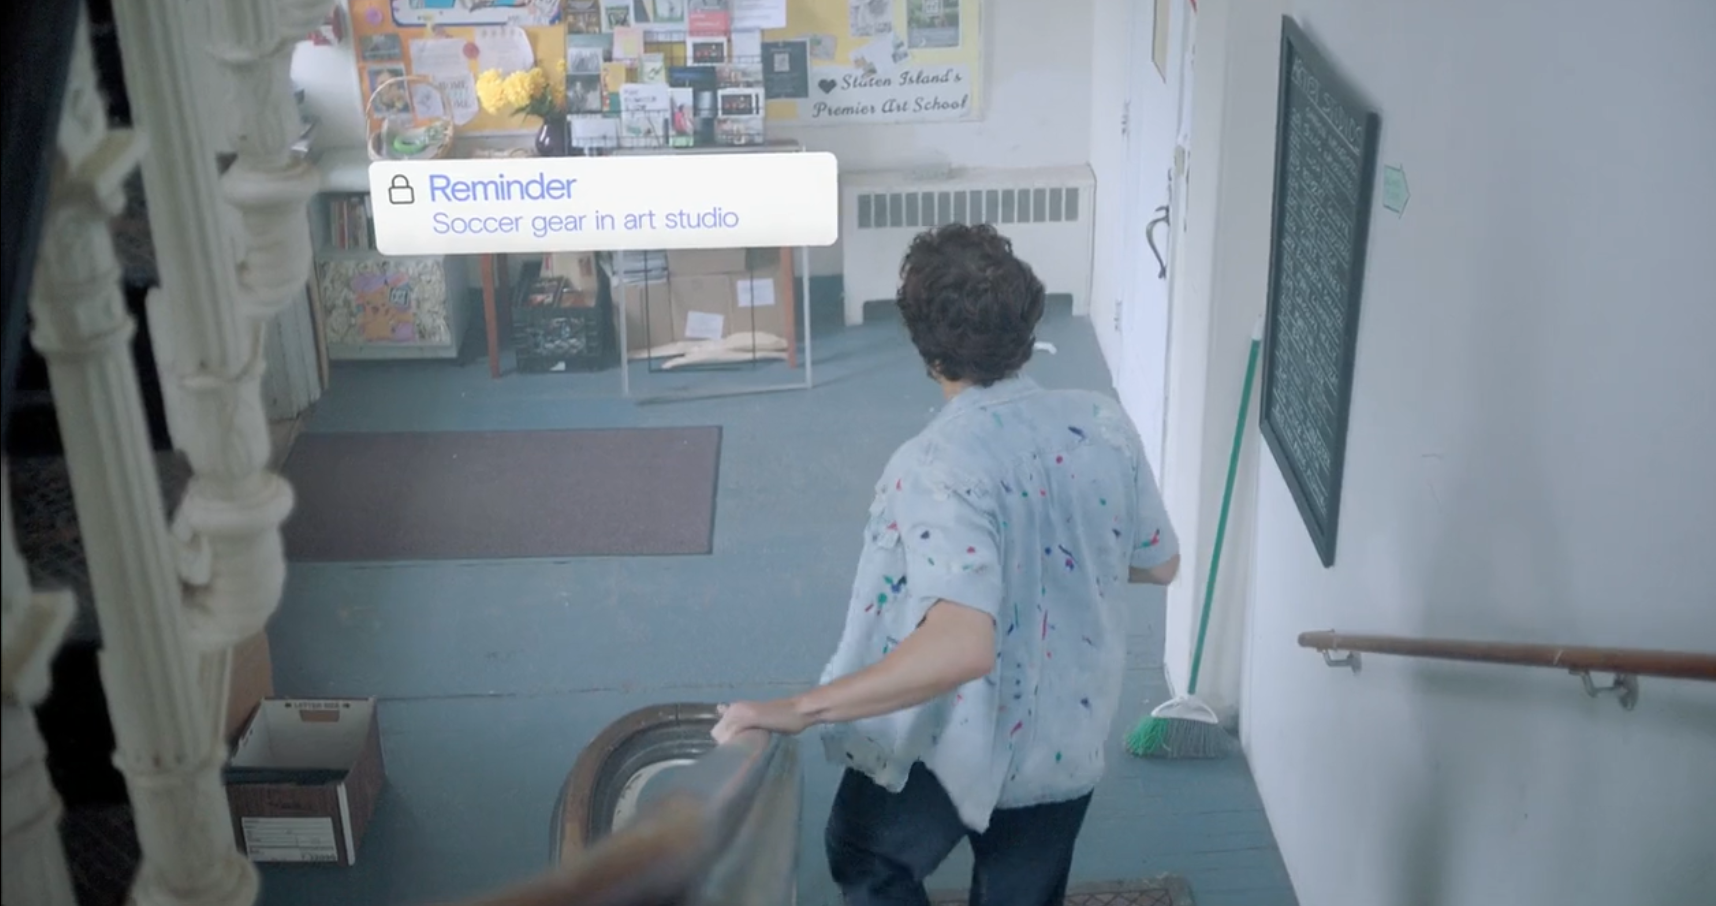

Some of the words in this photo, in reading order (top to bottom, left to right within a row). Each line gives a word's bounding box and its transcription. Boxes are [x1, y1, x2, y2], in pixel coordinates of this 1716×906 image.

[840, 73, 892, 91] Staten
[899, 69, 963, 87] Island's
[811, 101, 876, 119] Premier
[881, 98, 910, 114] Art
[912, 93, 969, 113] School
